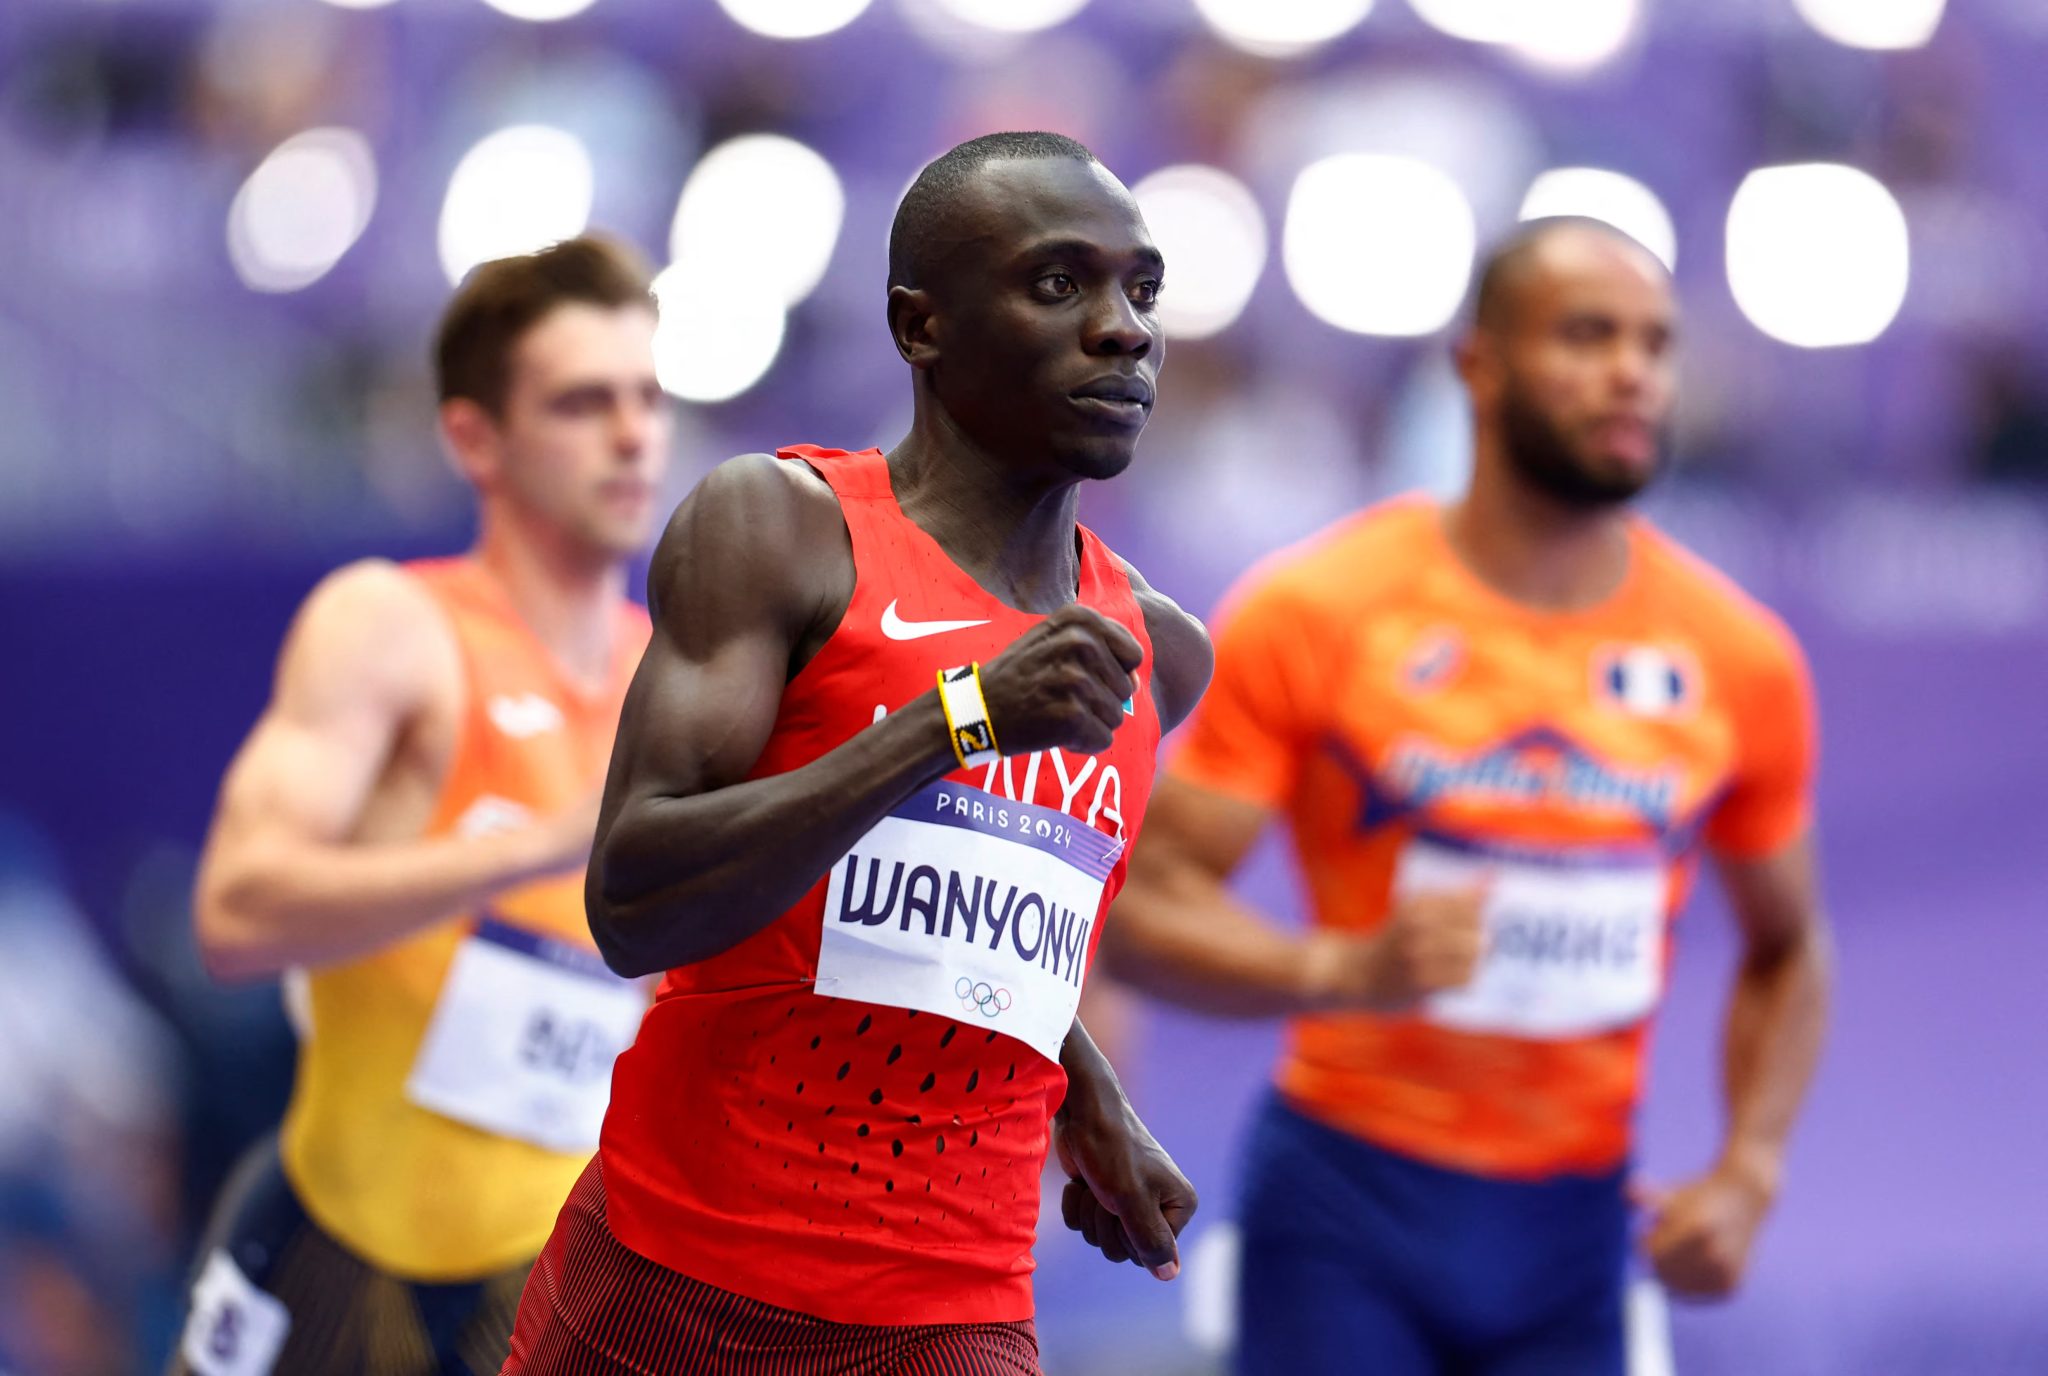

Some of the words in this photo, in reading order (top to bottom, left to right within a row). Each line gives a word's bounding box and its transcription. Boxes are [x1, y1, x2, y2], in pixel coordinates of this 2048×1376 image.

[936, 792, 1009, 828] PARIS
[1019, 814, 1072, 849] 2024
[838, 854, 1089, 988] WANYONYI
